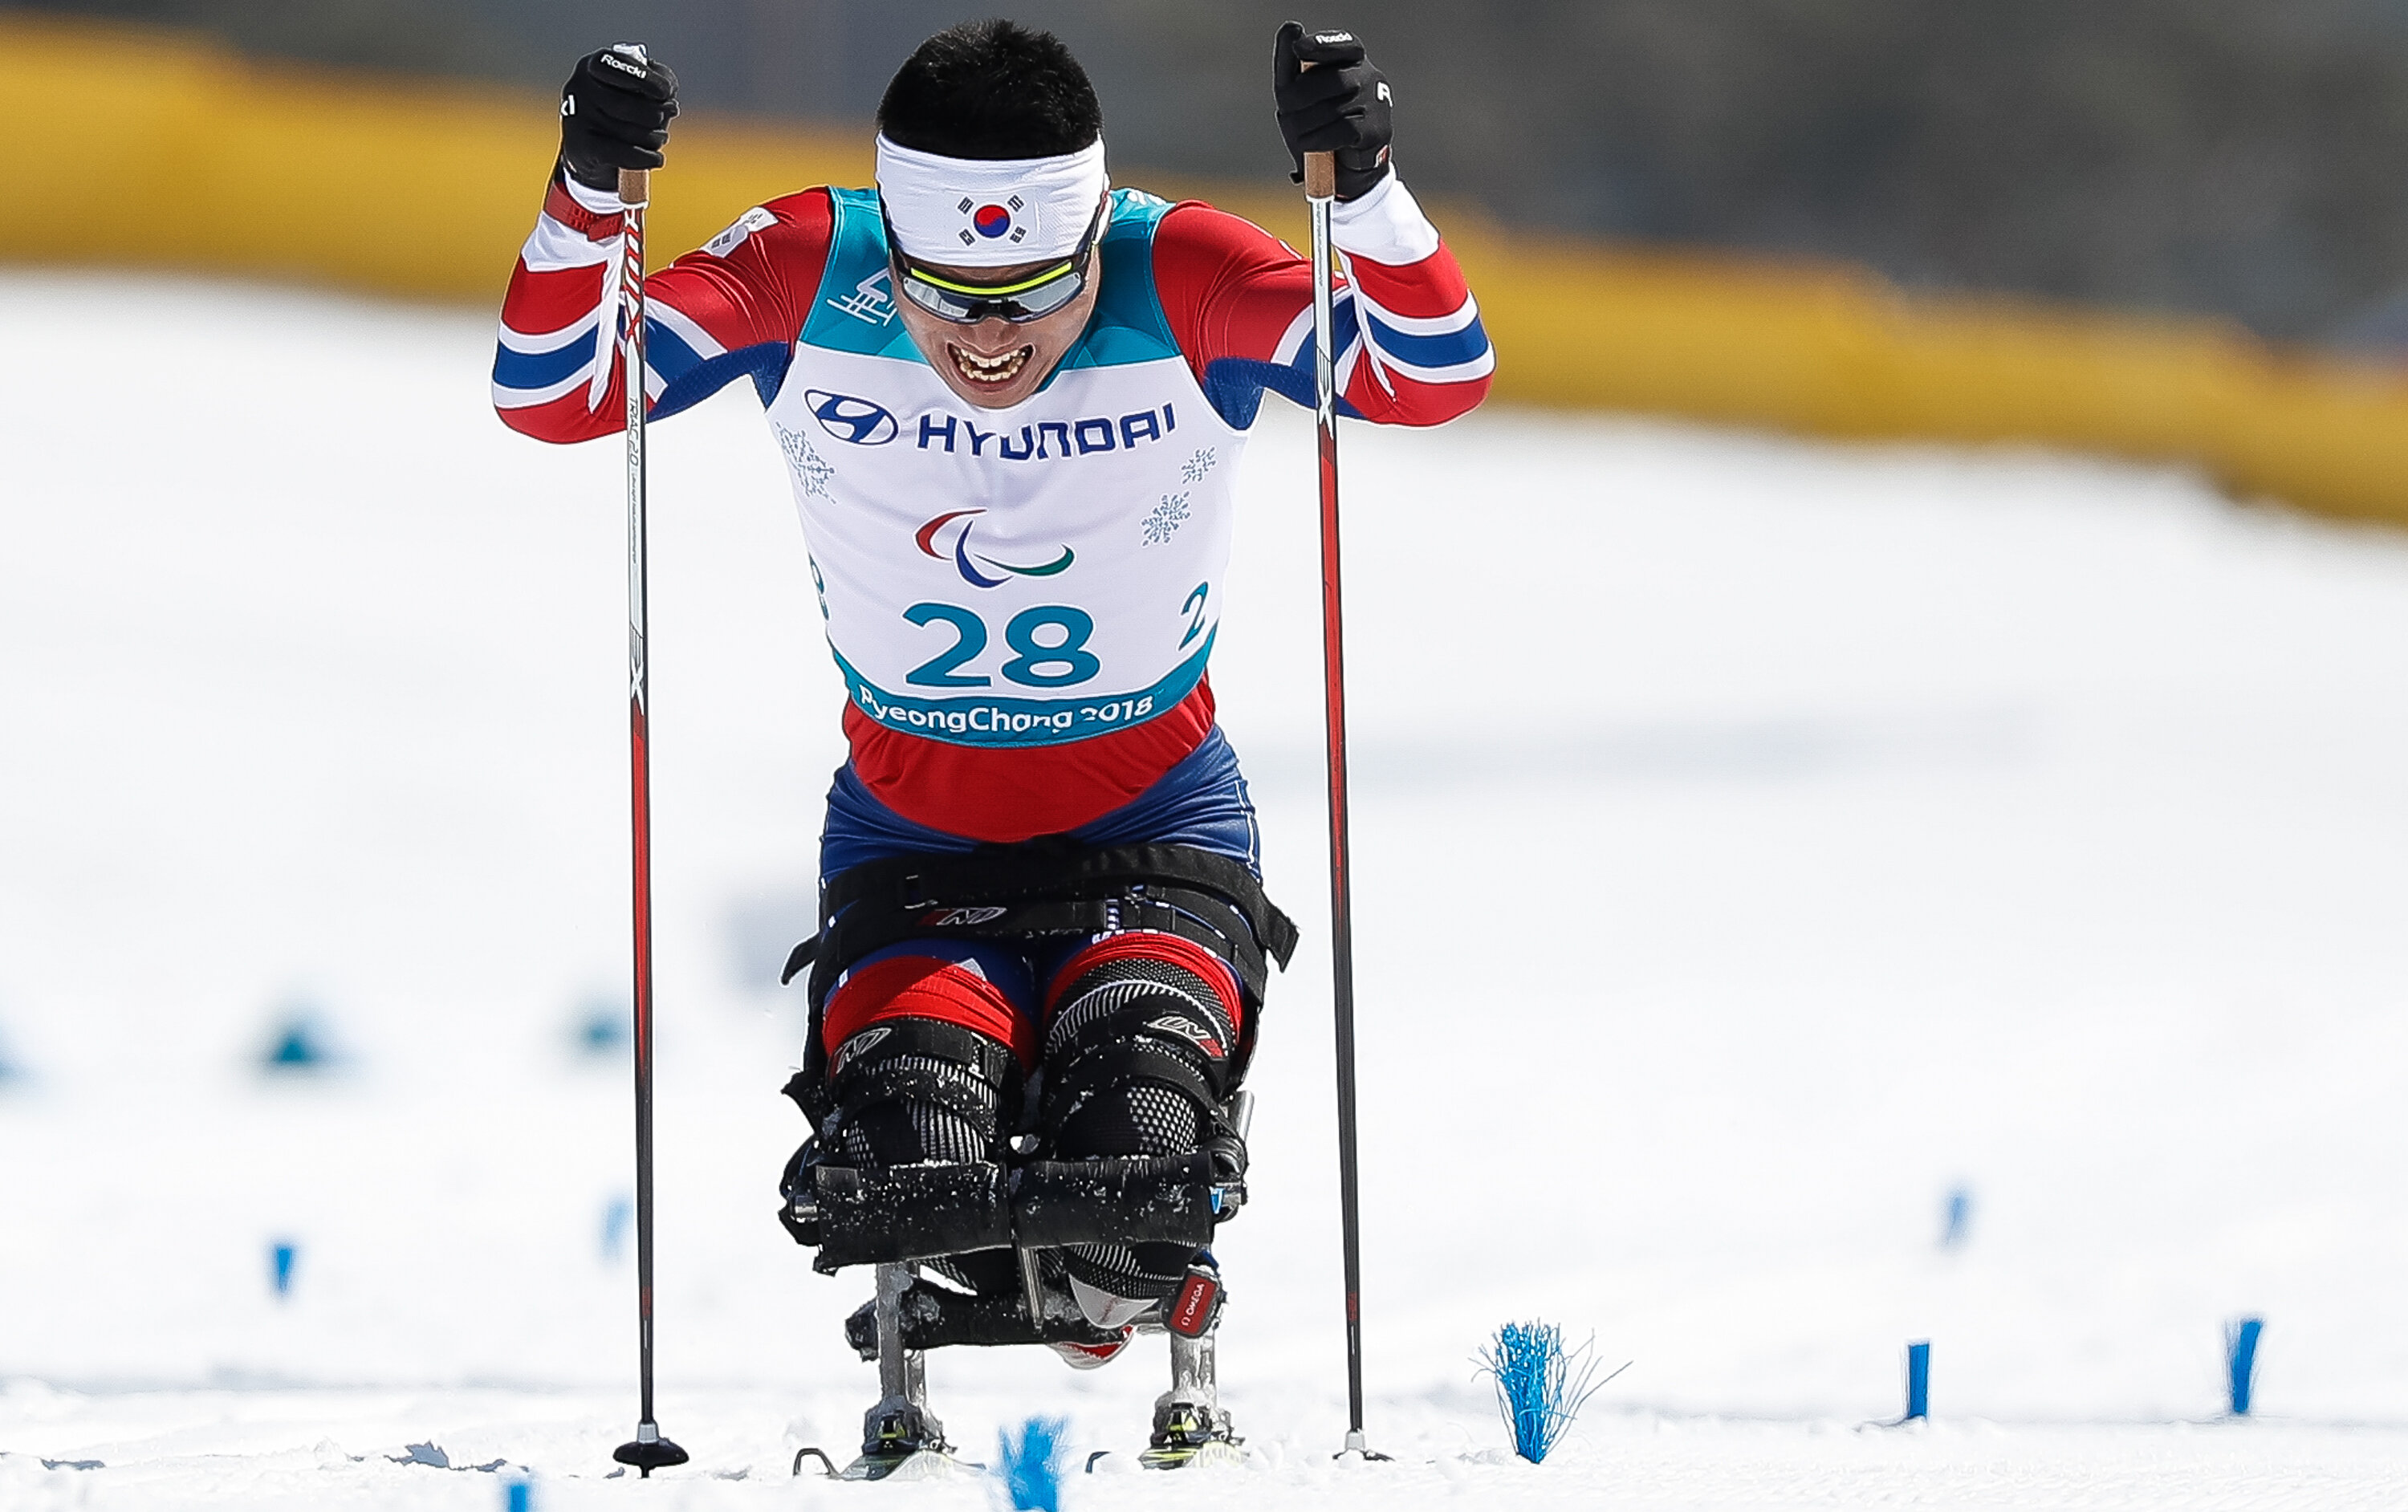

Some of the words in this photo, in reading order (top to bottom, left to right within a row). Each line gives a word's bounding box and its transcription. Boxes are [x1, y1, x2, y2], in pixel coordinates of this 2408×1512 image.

[917, 403, 1175, 461] HYUNDAI
[903, 603, 1100, 687] 28
[1178, 581, 1208, 651] 2
[859, 684, 1073, 734] PyeongChang
[1080, 695, 1153, 722] 2018
[1185, 1283, 1205, 1316] OMEGA
